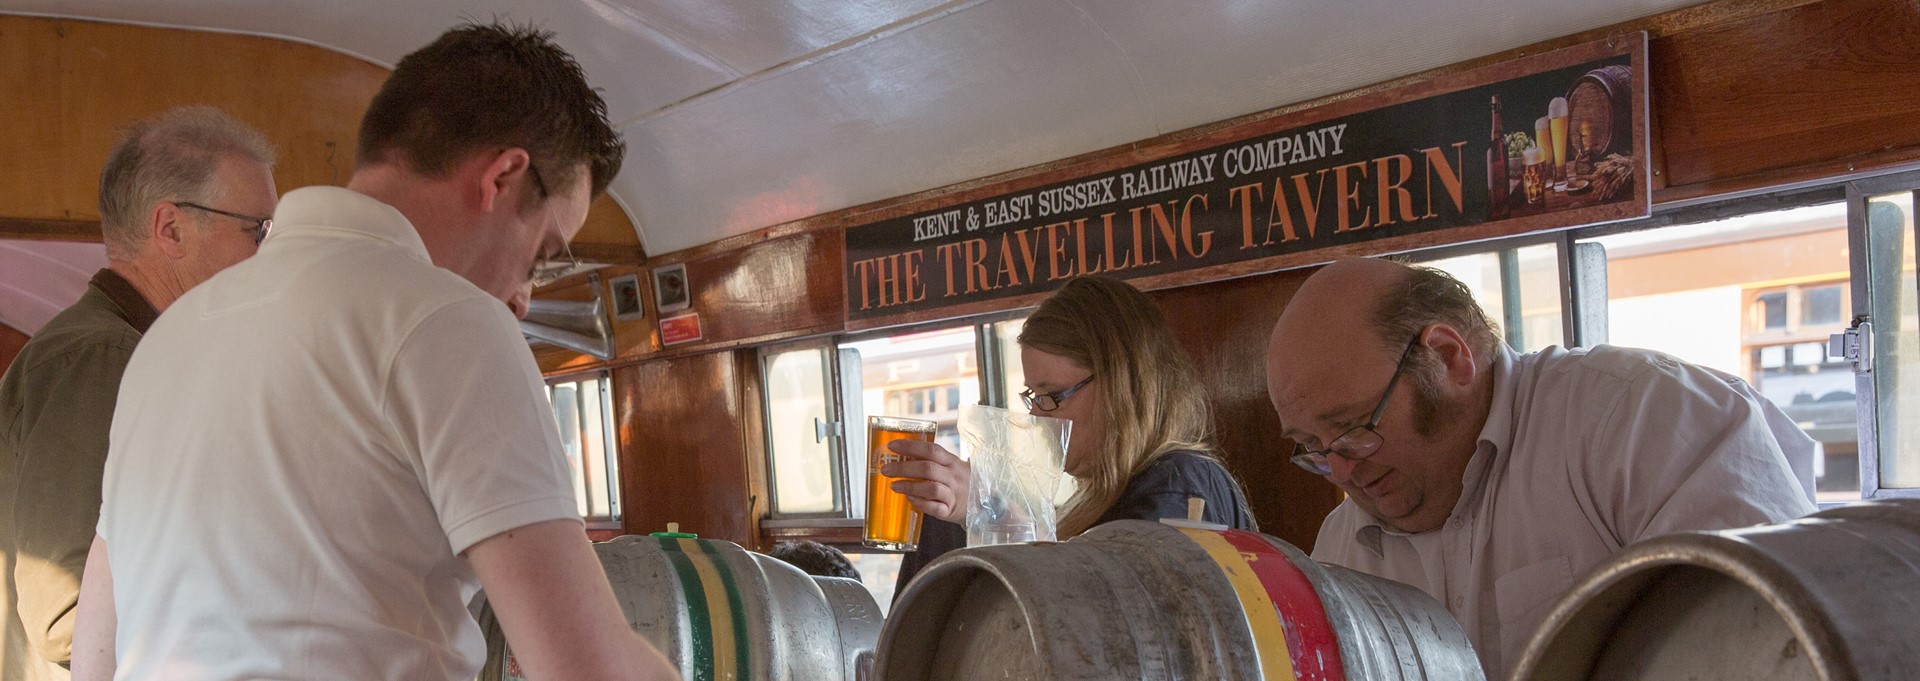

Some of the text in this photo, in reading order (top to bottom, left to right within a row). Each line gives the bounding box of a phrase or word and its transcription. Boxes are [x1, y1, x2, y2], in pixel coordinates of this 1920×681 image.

[853, 141, 1469, 311] THE TRAVELLING TAVERN
[913, 124, 1348, 242] KENT & EAST SUSSEX RAILWAY COMPANY
